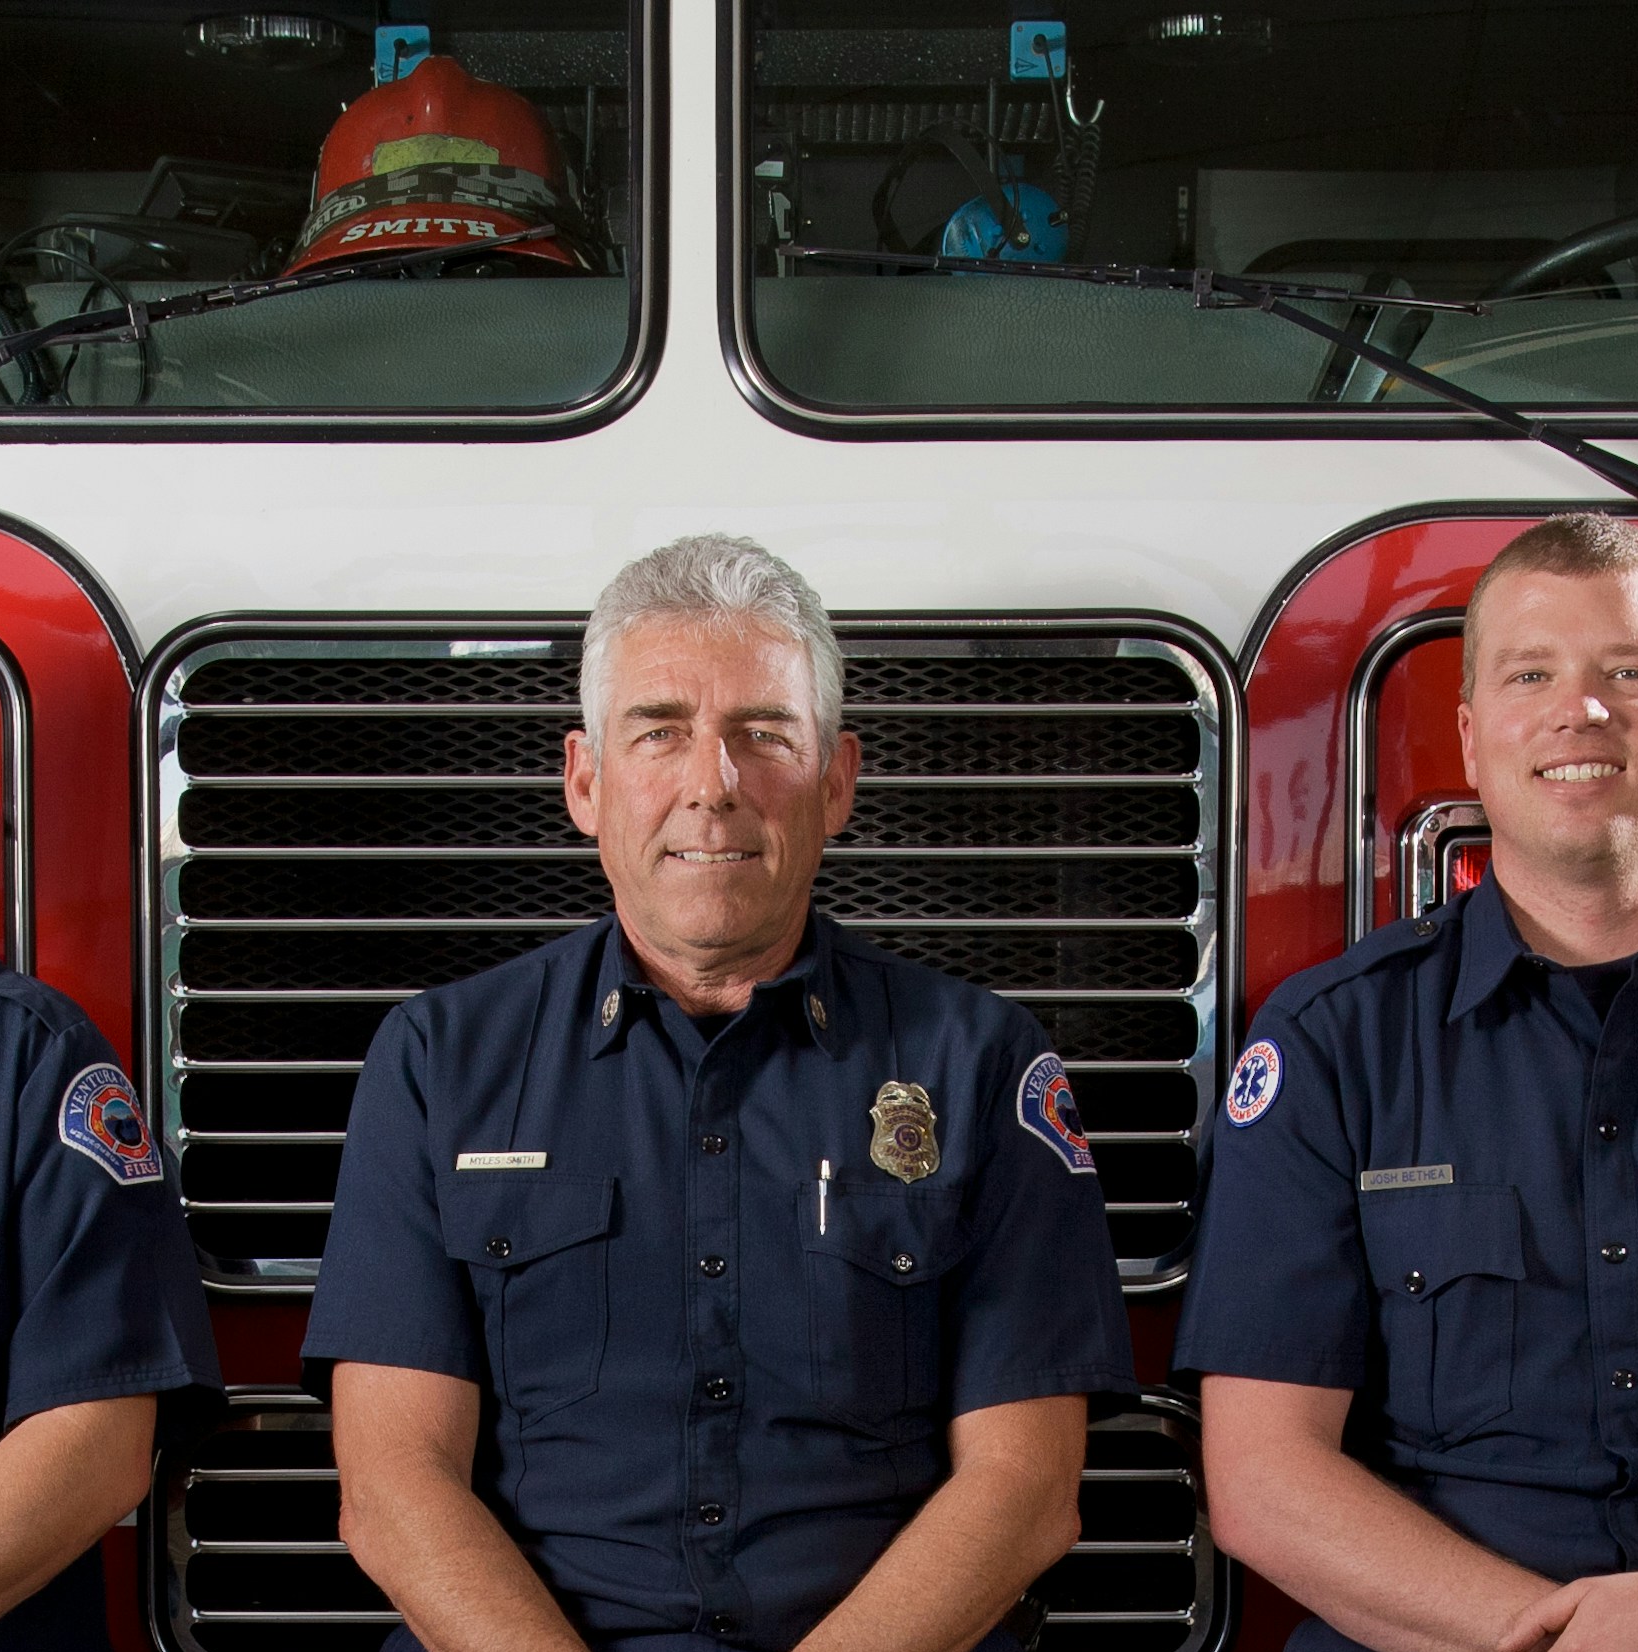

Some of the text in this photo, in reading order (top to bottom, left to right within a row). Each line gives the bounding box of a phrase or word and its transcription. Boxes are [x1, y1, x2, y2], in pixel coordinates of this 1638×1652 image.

[339, 218, 500, 244] SMITH
[1235, 1045, 1277, 1074] EMERGENCY
[69, 1069, 118, 1115] VENTURA
[1026, 1059, 1063, 1099] VENTU
[124, 1162, 158, 1177] FIRE
[469, 1156, 534, 1165] MYLES SMITH
[1370, 1169, 1446, 1185] JOSH BETHEA
